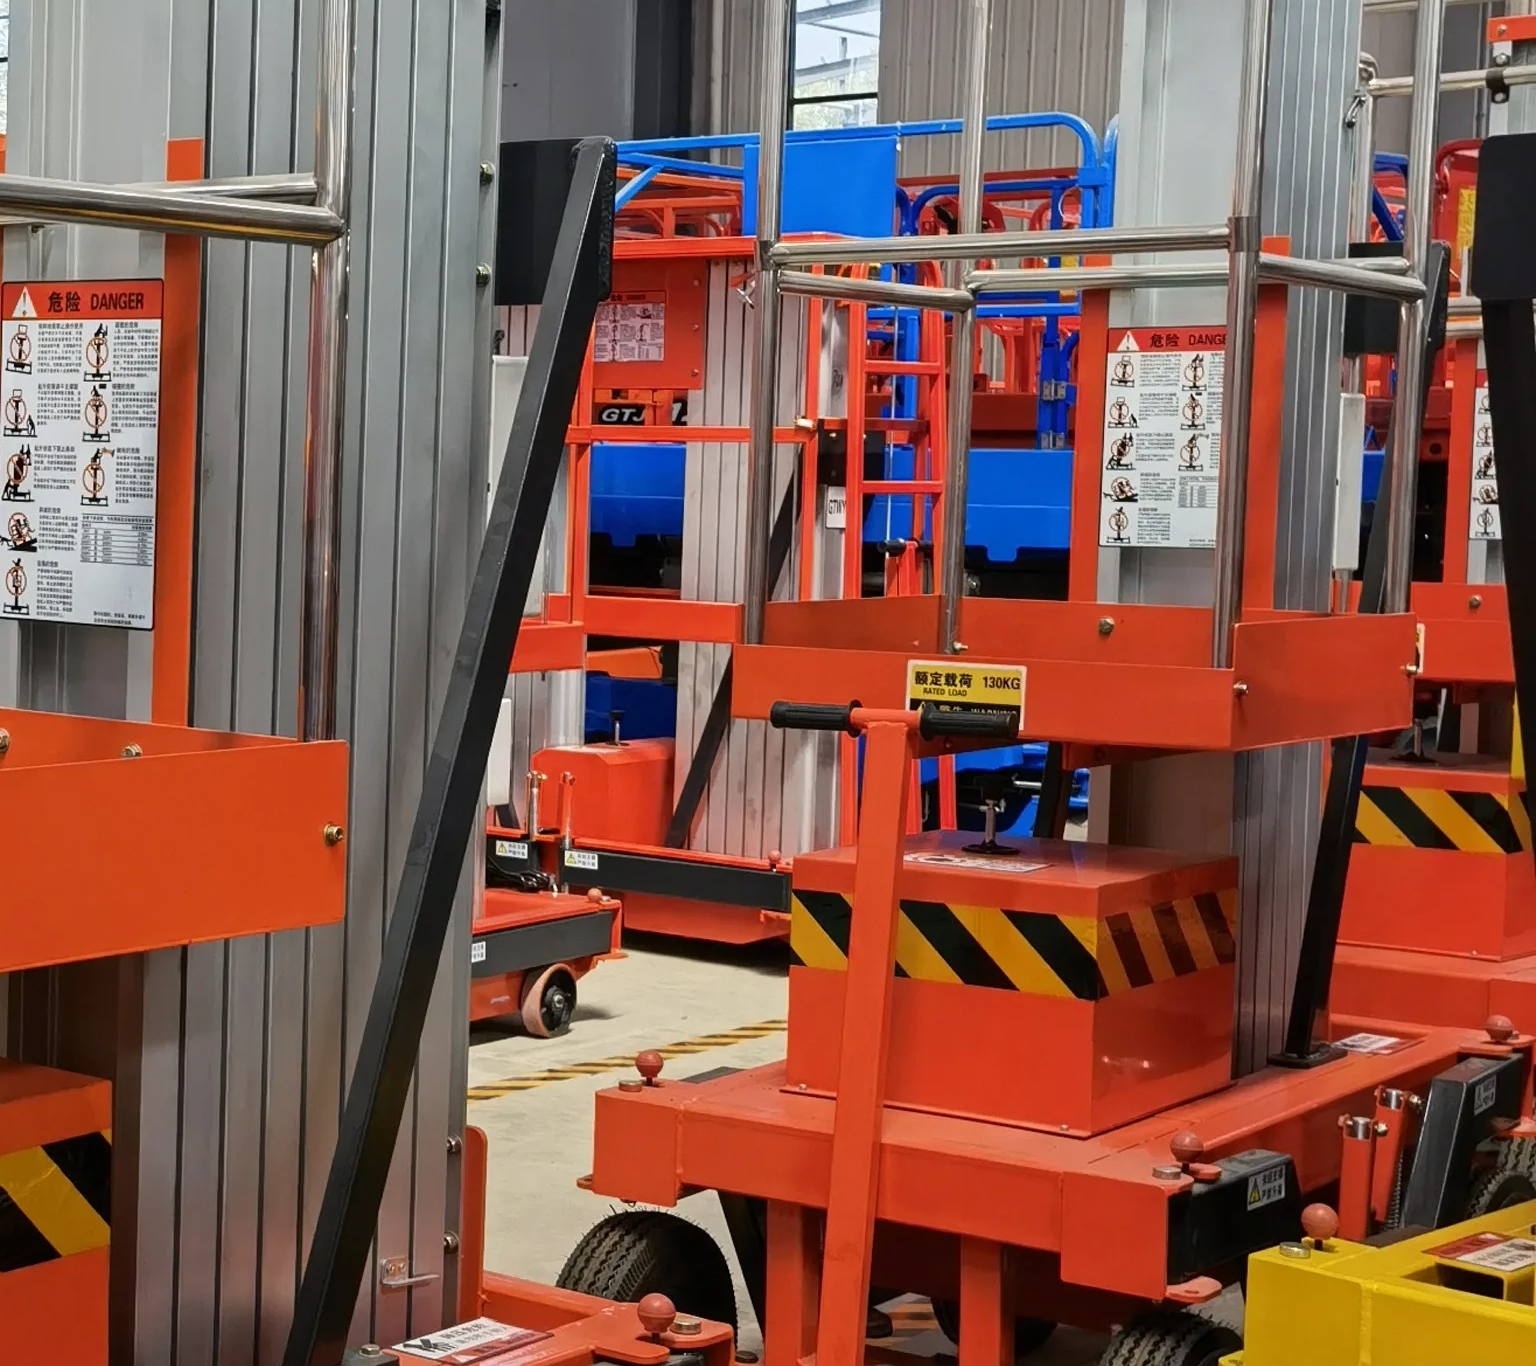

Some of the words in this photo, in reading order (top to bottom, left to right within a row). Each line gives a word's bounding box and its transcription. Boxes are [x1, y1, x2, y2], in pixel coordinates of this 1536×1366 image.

[48, 290, 82, 313] 危险
[90, 291, 144, 311] DANGER
[1149, 333, 1180, 348] 危险
[1188, 333, 1226, 345] DANG
[915, 671, 972, 688] 额定载荷
[982, 676, 1021, 690] 130KG
[923, 687, 945, 696] RATED
[948, 688, 967, 697] LOAD
